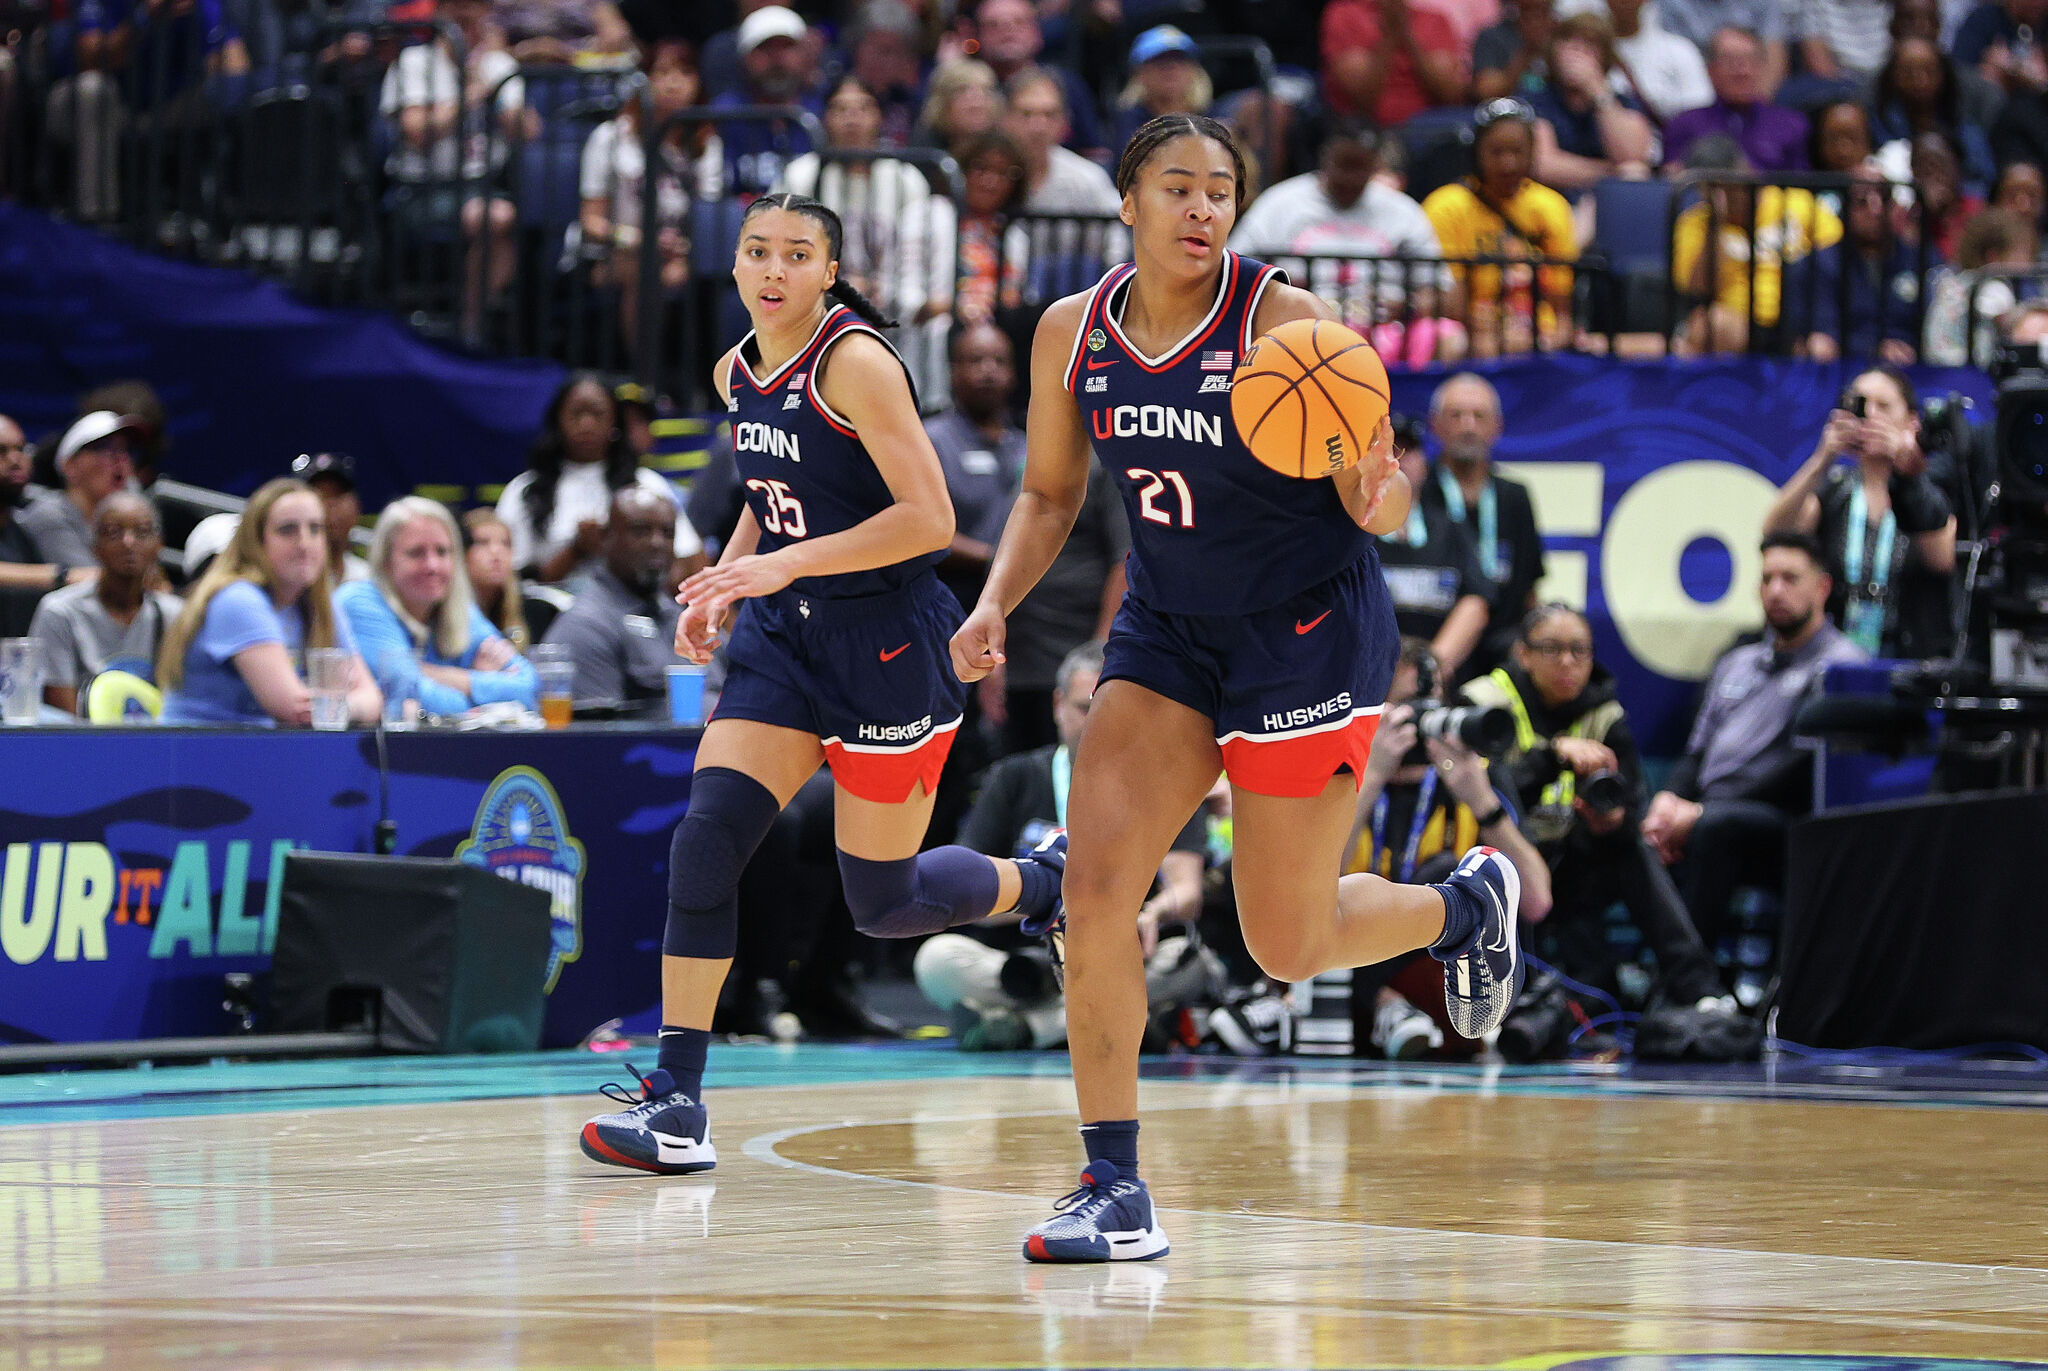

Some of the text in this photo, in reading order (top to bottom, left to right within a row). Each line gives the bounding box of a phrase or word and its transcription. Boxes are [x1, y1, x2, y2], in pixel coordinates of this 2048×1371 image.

[1084, 383, 1108, 393] CHANGE
[1086, 375, 1108, 385] BE THE
[1199, 382, 1235, 390] EAST
[1203, 374, 1229, 383] BIG
[733, 421, 801, 463] CONN
[1092, 404, 1223, 447] UCONN
[745, 477, 808, 539] 35
[1125, 467, 1195, 528] 21
[858, 714, 932, 741] HUSKIES
[1263, 691, 1352, 731] HUSKIES
[114, 868, 162, 925] IT
